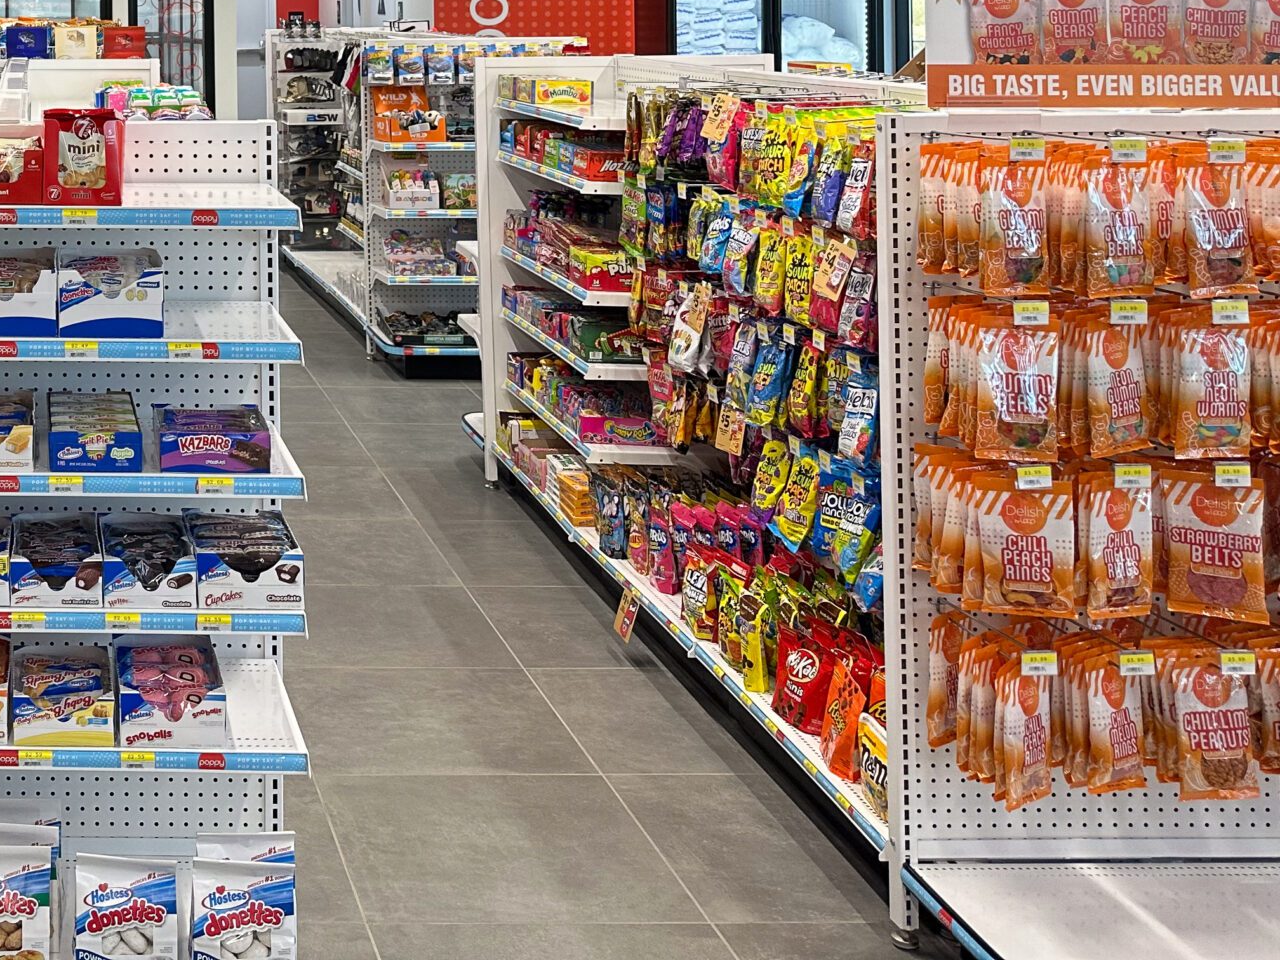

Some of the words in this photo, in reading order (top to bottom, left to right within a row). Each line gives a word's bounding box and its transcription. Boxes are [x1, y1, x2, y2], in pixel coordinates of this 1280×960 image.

[1050, 9, 1098, 24] GUMMI
[1122, 6, 1167, 22] PEACH
[1187, 9, 1214, 23] CHILI
[1218, 11, 1245, 24] LIME
[988, 23, 1023, 36] FANCY
[1055, 24, 1095, 38] BEARS
[1124, 23, 1166, 38] RINGS
[1191, 23, 1240, 37] PEANUTS
[980, 34, 1033, 48] CHOCOLATE
[550, 88, 578, 98] Mamba
[948, 75, 985, 96] BIG
[993, 75, 1069, 100] TASTE,
[1077, 75, 1133, 96] EVEN
[1141, 74, 1223, 96] BIGGER
[68, 140, 101, 154] mini
[786, 279, 808, 294] PATCH
[1110, 369, 1134, 386] NEON
[1205, 372, 1236, 386] SOUR
[1108, 382, 1141, 403] GUMMI
[1112, 399, 1140, 417] BEARS
[1197, 402, 1246, 416] WORMS
[179, 435, 232, 452] KAZBARS
[1006, 504, 1044, 516] Delish
[1008, 536, 1046, 551] CHILI
[1108, 531, 1133, 547] CHILI
[1171, 528, 1260, 552] STRAWBERRY
[1004, 550, 1051, 567] PEACH
[1104, 545, 1139, 563] MELON
[1192, 545, 1241, 567] BELTS
[1006, 565, 1050, 582] RINGS
[266, 594, 301, 602] Chocolate
[1111, 709, 1130, 728] CHILI
[1184, 712, 1217, 730] CHILI
[1110, 721, 1137, 744] MELON
[1191, 730, 1249, 750] PEANUTS
[1113, 738, 1137, 759] RINGS
[91, 888, 130, 905] Hostess
[208, 890, 248, 907] Hostess
[87, 902, 166, 933] donettes
[205, 903, 283, 937] donettes
